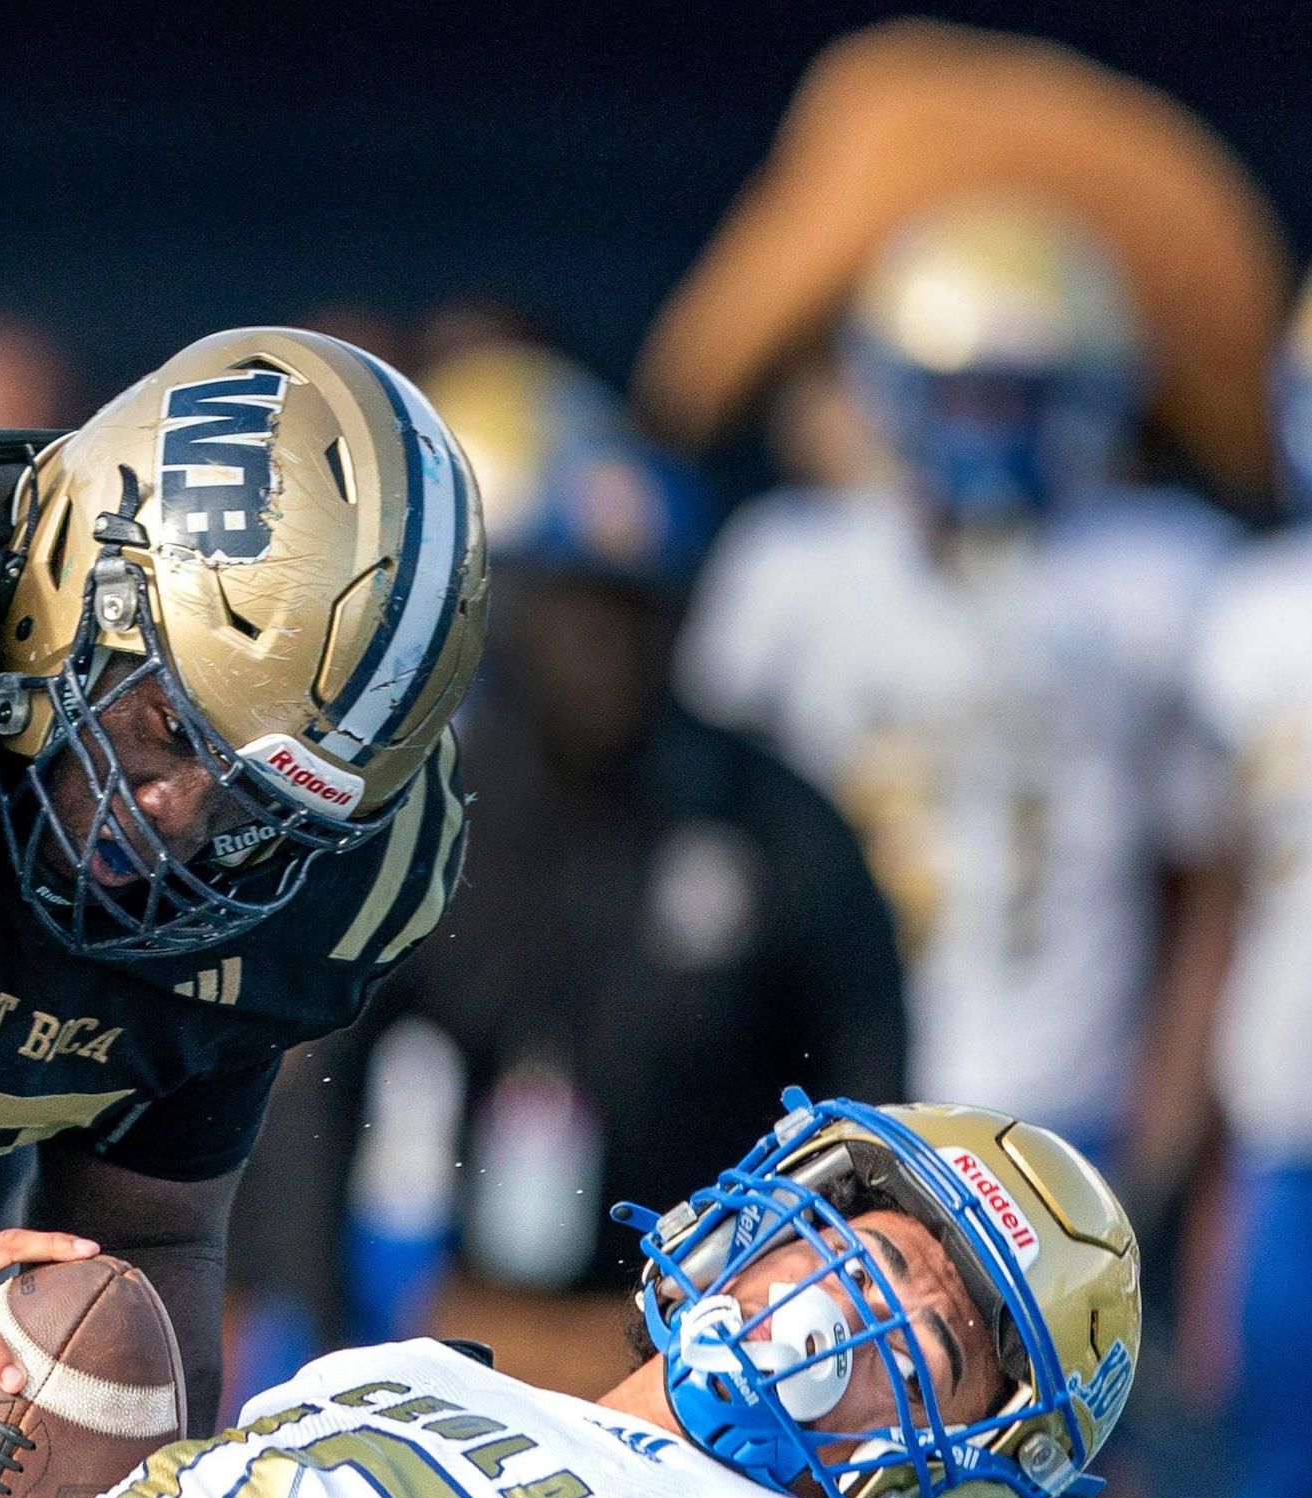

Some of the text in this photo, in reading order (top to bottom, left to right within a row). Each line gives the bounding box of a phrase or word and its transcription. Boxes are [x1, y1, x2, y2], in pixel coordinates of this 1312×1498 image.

[156, 368, 291, 565] WB
[266, 747, 354, 806] Riddell
[213, 825, 275, 856] Ridd
[953, 1154, 1035, 1249] Riddell
